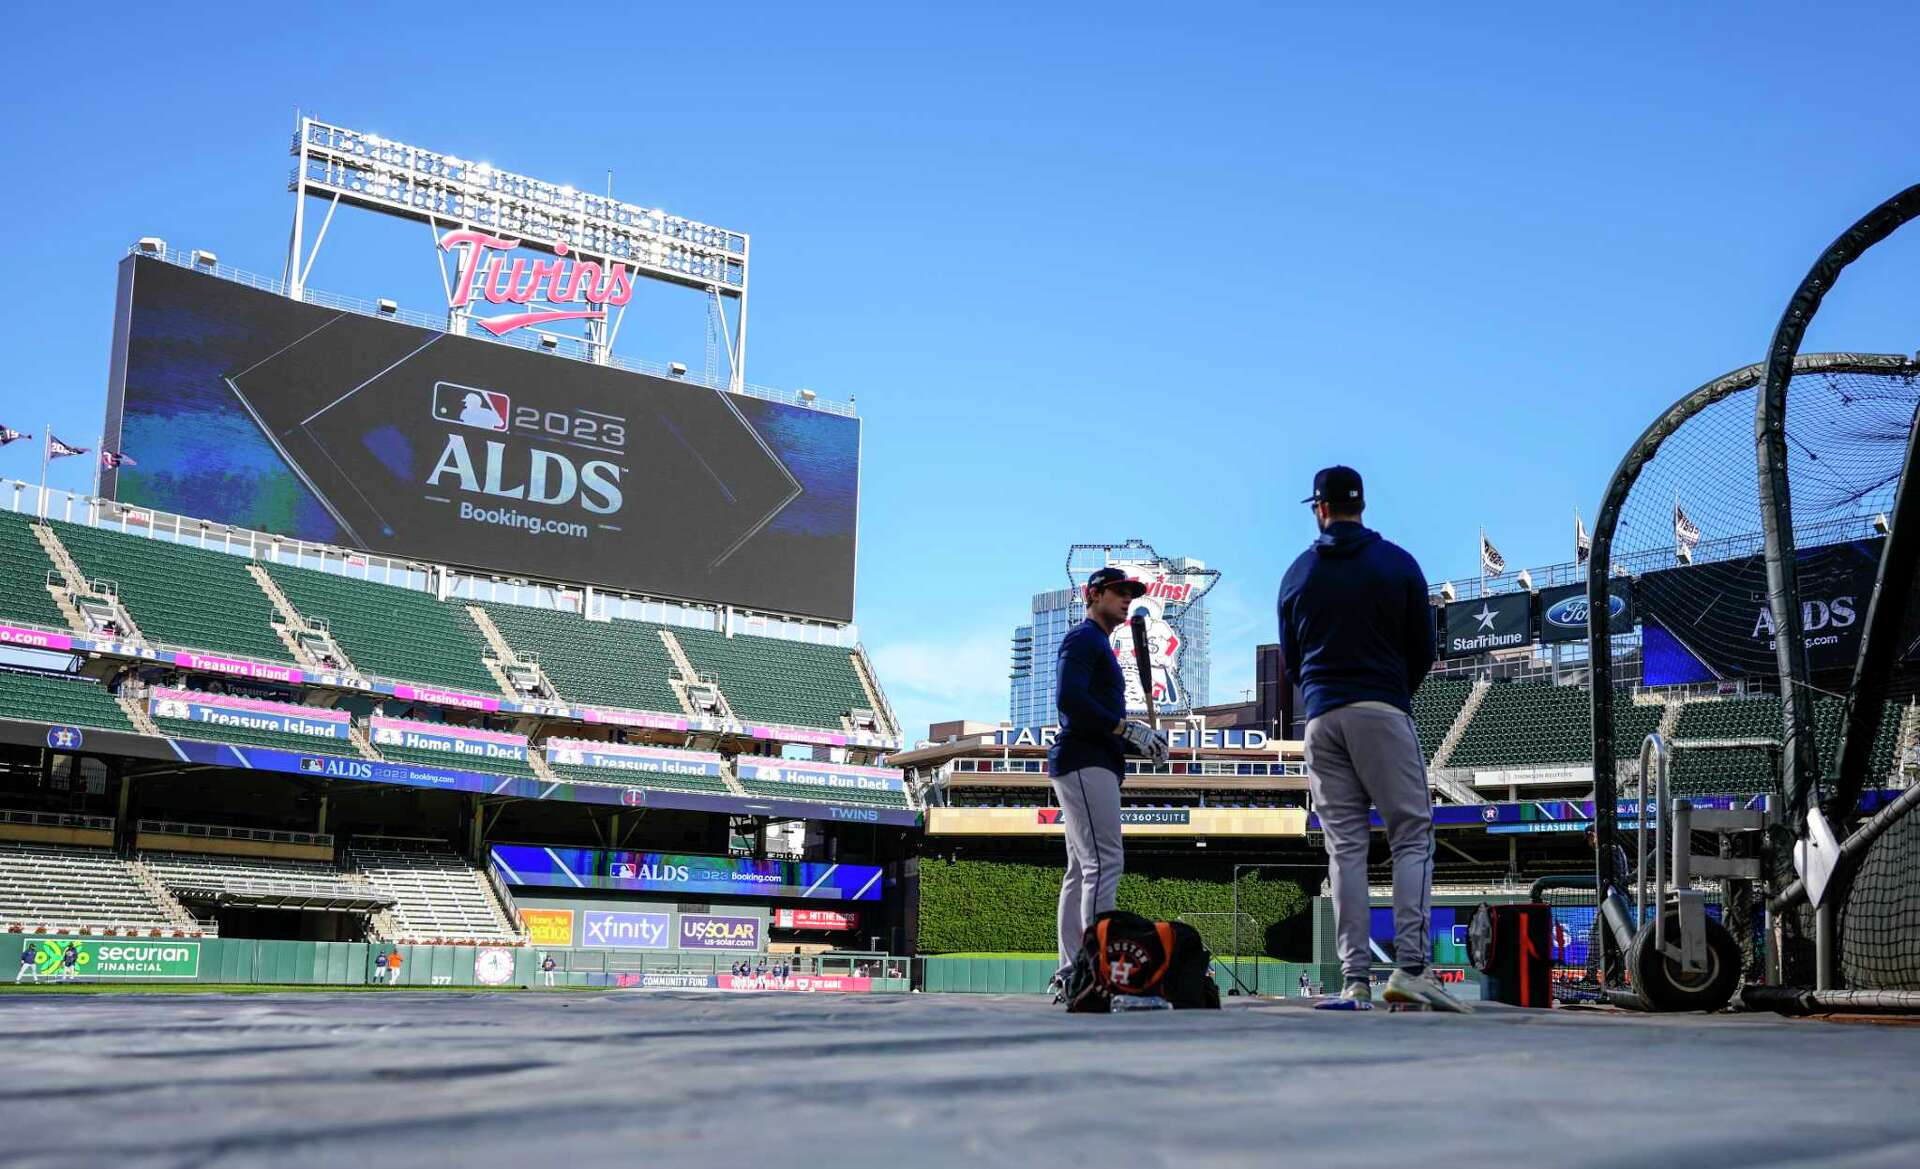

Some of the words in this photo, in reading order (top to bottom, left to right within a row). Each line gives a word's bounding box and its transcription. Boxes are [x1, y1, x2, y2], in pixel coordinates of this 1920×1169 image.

[439, 229, 633, 308] Twins
[515, 405, 626, 446] 2023
[426, 433, 624, 515] ALDS
[460, 501, 588, 538] Booking.com
[1561, 601, 1590, 623] Fo
[1751, 596, 1857, 638] ADS
[1453, 631, 1523, 651] StarTribune
[190, 655, 248, 675] Treasure
[251, 664, 290, 681] Island
[200, 708, 279, 731] Treasure
[283, 718, 337, 738] Island
[407, 734, 450, 750] Home
[455, 740, 483, 755] Run
[487, 744, 523, 761] Deck
[999, 727, 1057, 746] TAR
[1168, 729, 1267, 749] FIELD
[326, 760, 372, 778] ALDS
[410, 772, 455, 784] Booking.com
[593, 755, 659, 771] Treasure
[663, 761, 706, 776] Island
[787, 771, 826, 785] Home
[829, 775, 854, 786] Run
[858, 778, 890, 790] Deck
[830, 808, 878, 822] TWINS
[1528, 822, 1579, 832] TREASURE
[638, 864, 689, 882] ALDS
[732, 871, 782, 883] Booking.com
[588, 916, 664, 944] xfinity
[704, 937, 754, 947] us-solar.com
[97, 946, 189, 962] securian
[97, 962, 162, 972] FINANCIAL
[432, 976, 452, 985] 377
[643, 976, 688, 986] COMMUNITY
[688, 976, 708, 986] FUND
